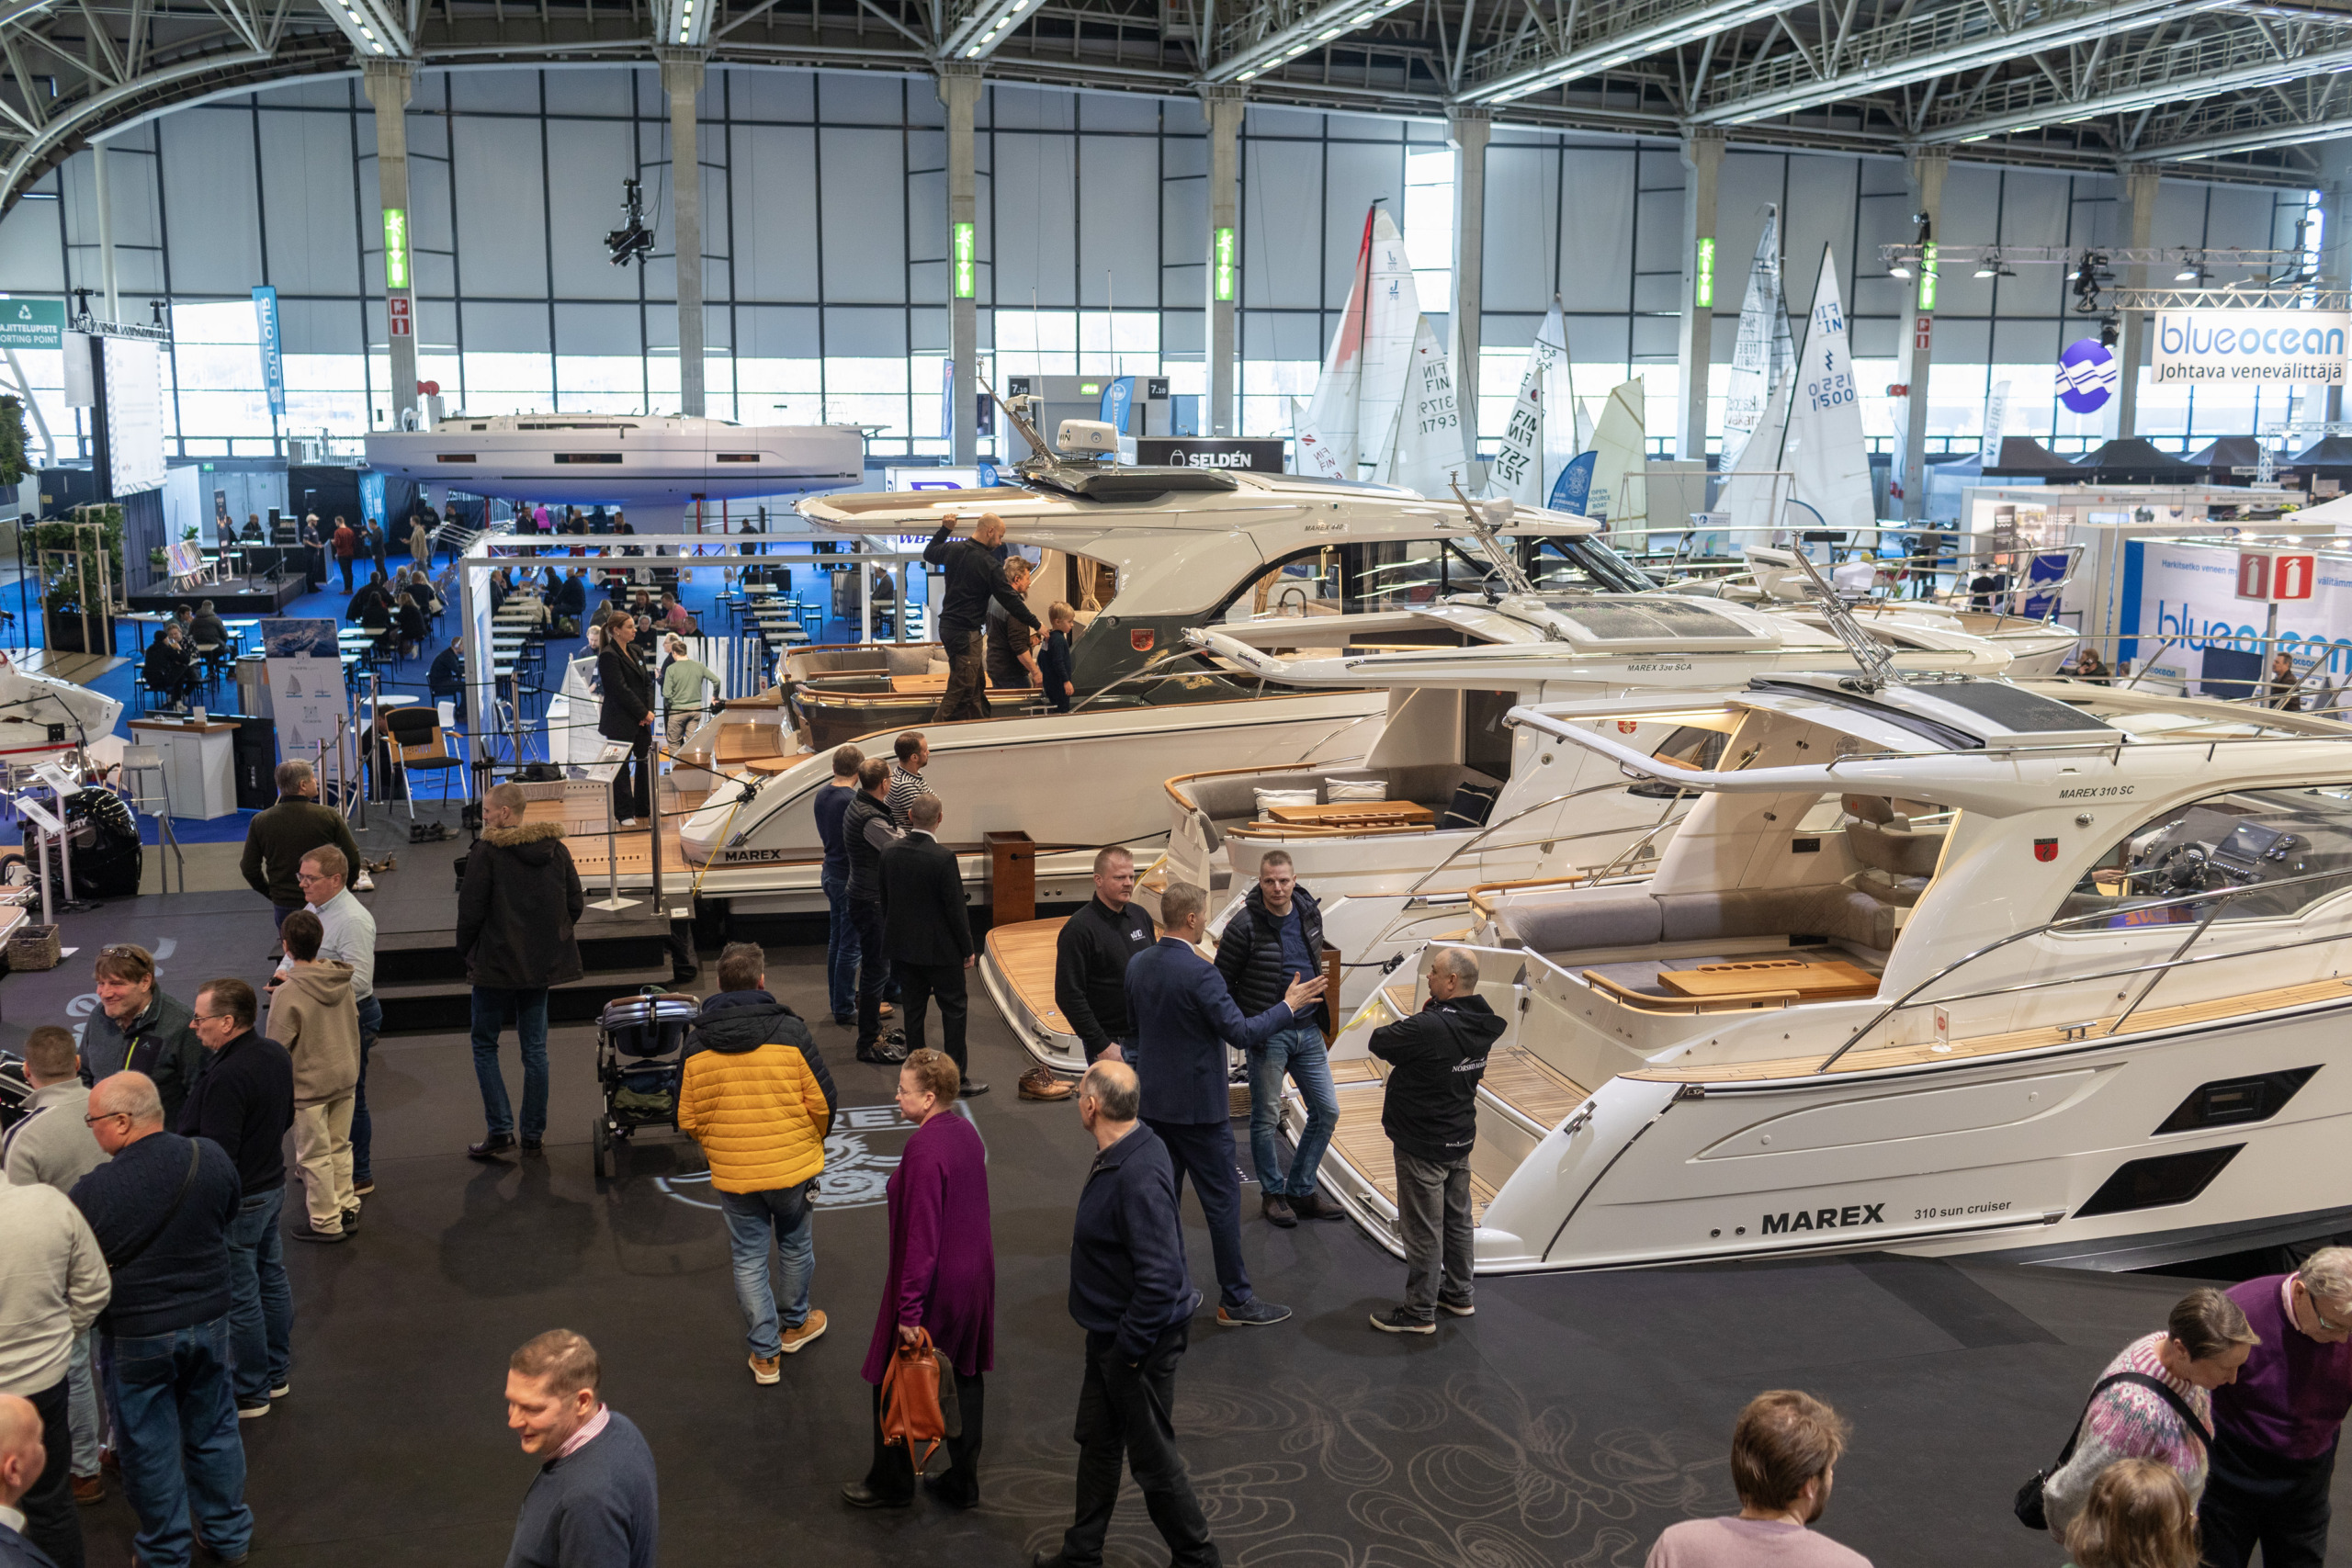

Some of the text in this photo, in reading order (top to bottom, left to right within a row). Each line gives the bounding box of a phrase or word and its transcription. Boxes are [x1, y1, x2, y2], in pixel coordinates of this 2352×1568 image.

[1817, 318, 1843, 333] IN
[33, 335, 58, 344] POINT
[2161, 316, 2343, 355] blueocean
[2159, 363, 2342, 383] Johtava venevälittäjä
[1150, 385, 1166, 394] 7.10
[1426, 376, 1450, 393] FIN
[1189, 450, 1252, 468] SELDÉN
[2162, 559, 2200, 571] Harkitsetko
[2202, 565, 2226, 575] veneen
[2059, 785, 2135, 799] MAREX 310 SC
[725, 850, 781, 862] MAREX
[1761, 1200, 2012, 1235] MAREX 310 sun cruiser
